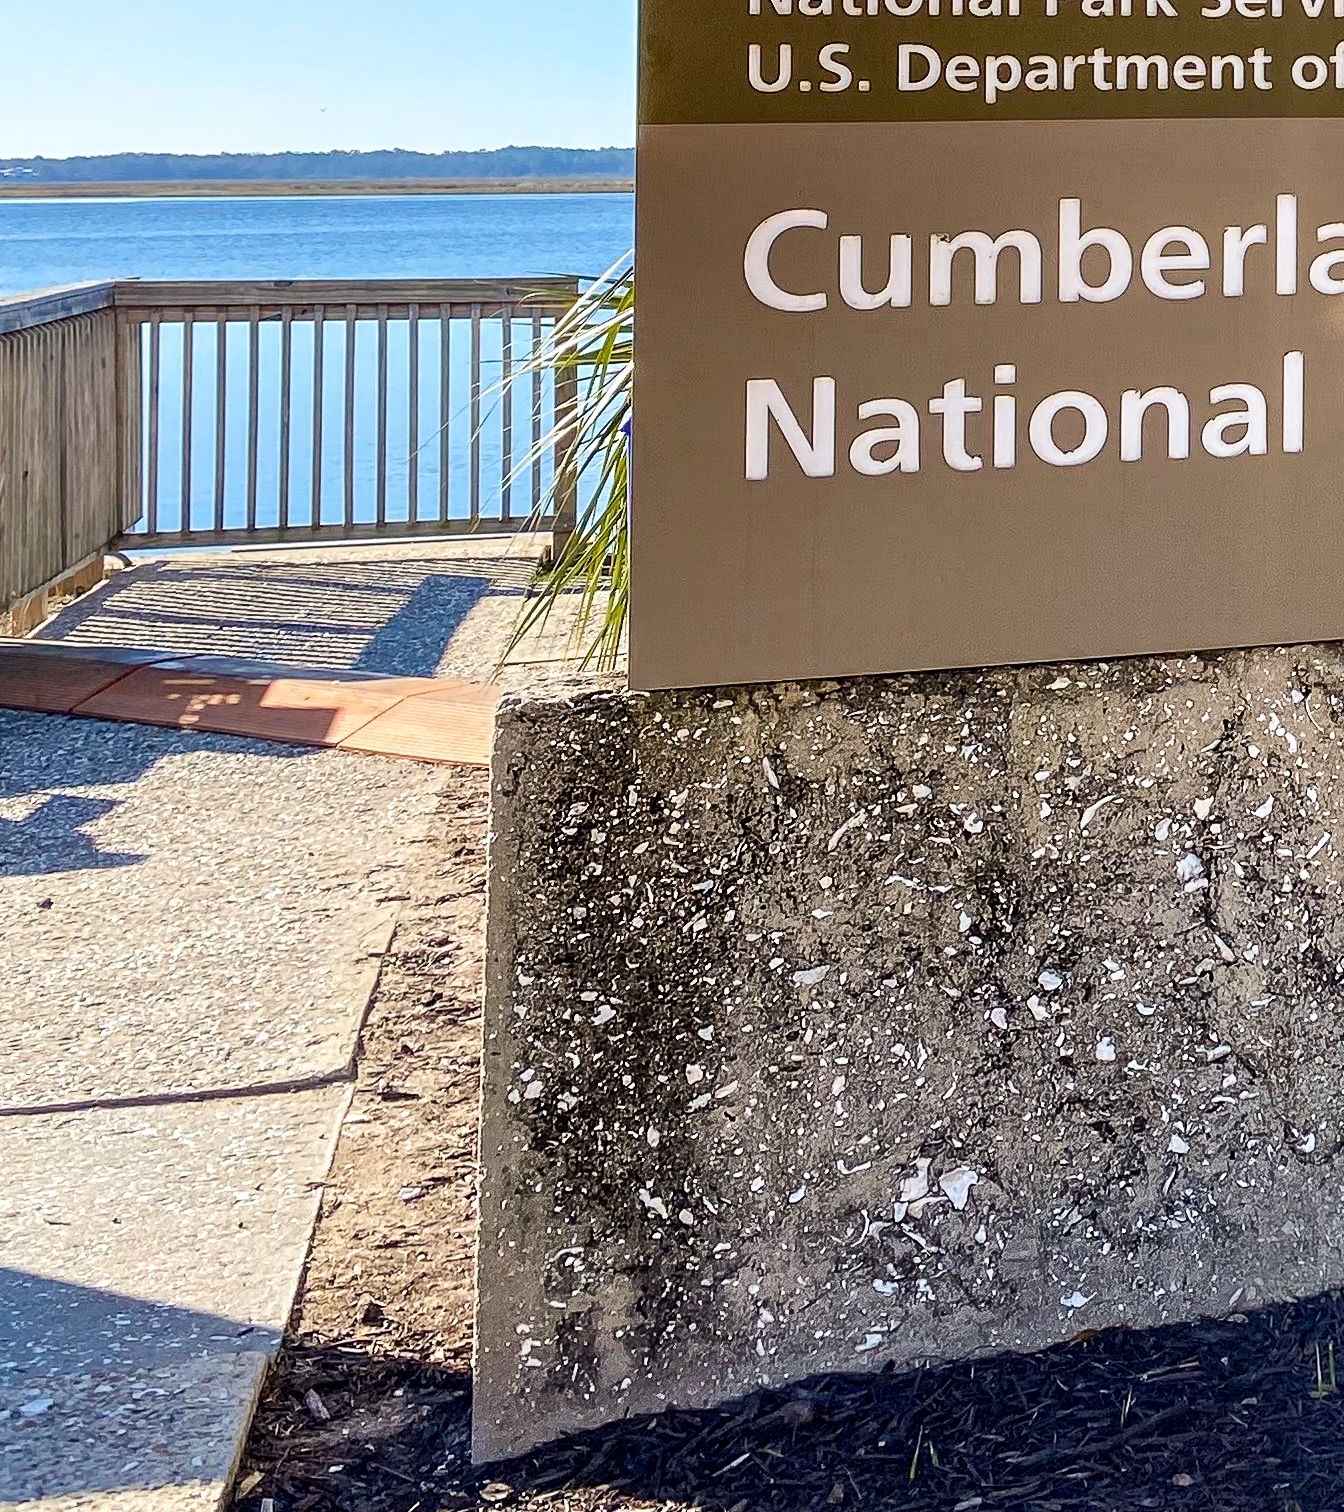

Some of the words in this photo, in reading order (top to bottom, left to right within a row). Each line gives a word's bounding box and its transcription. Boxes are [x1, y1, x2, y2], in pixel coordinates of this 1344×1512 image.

[747, 42, 871, 94] U.S.
[897, 43, 1275, 106] Department
[743, 350, 1306, 481] National
